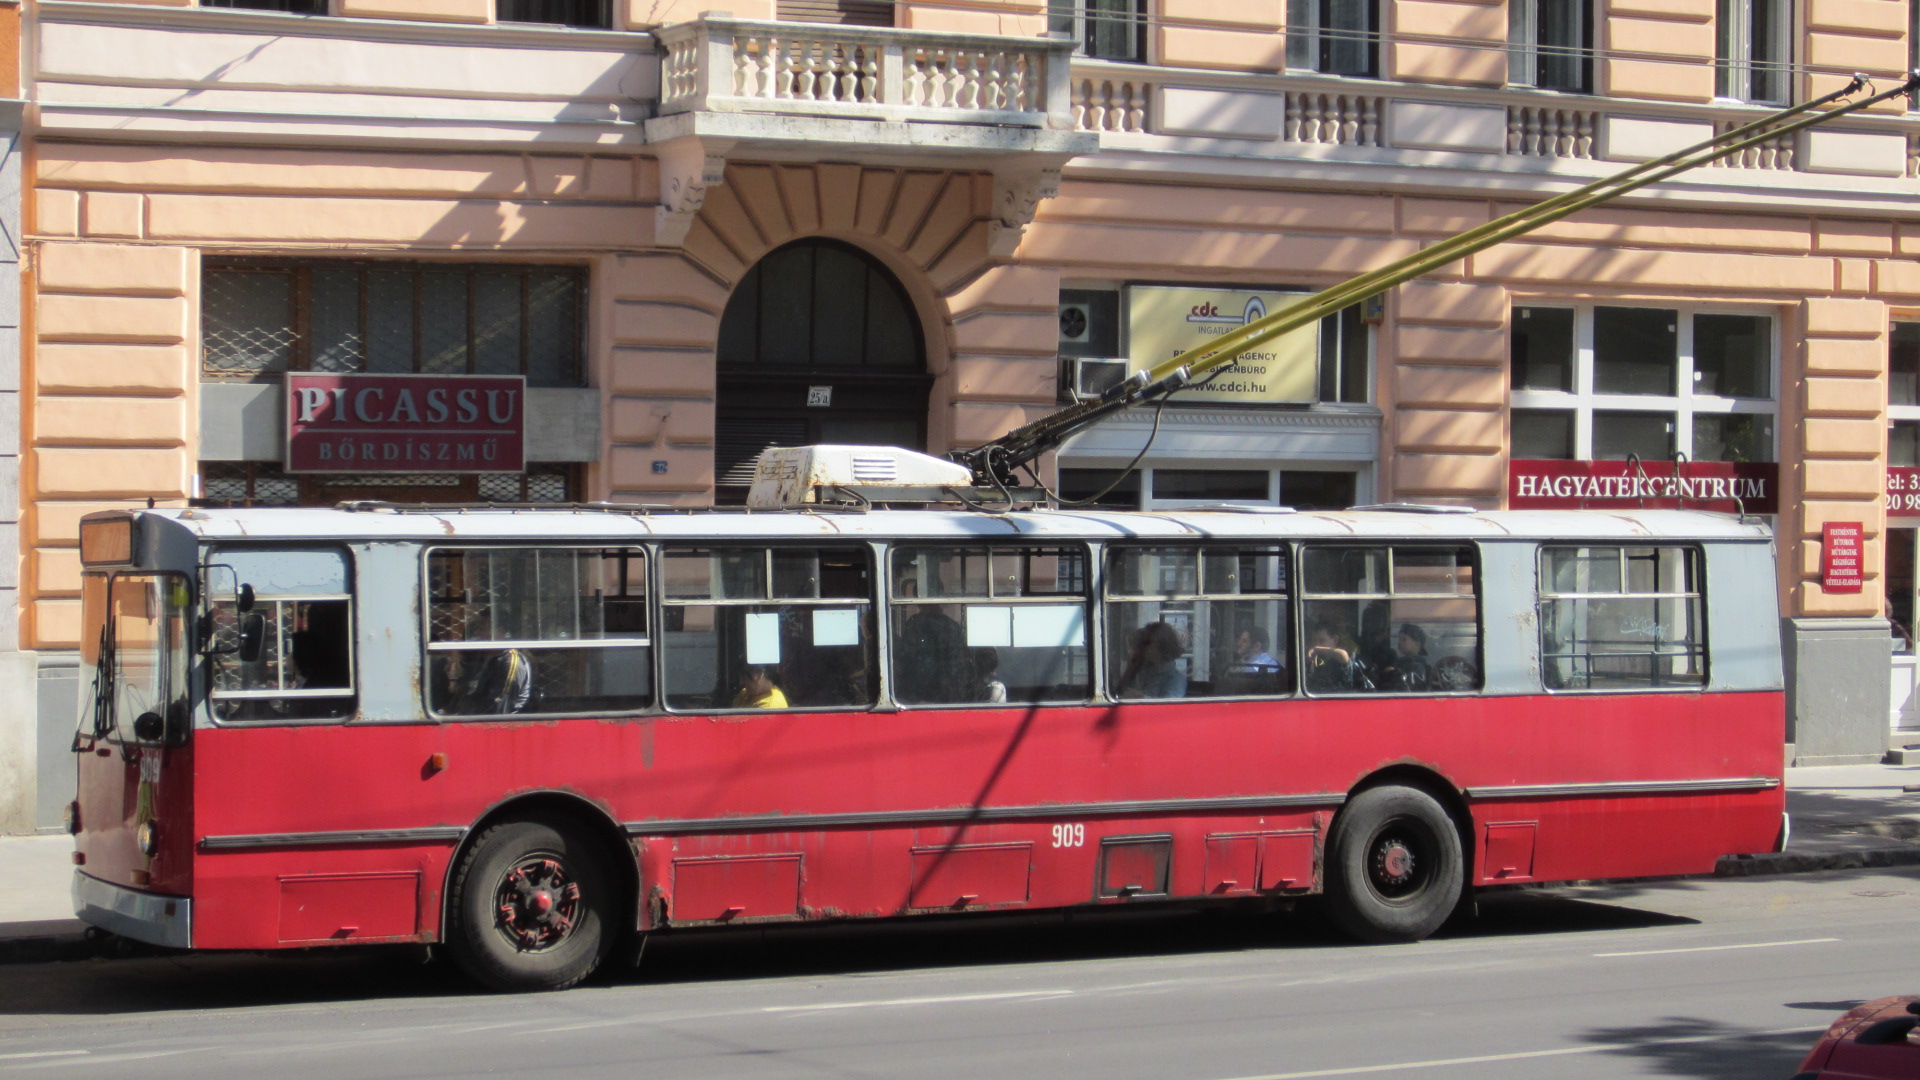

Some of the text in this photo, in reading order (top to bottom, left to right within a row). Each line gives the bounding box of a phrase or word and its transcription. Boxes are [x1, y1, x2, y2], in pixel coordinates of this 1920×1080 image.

[1191, 301, 1218, 317] cdc
[1239, 352, 1277, 361] AGENCY
[1184, 381, 1267, 393] ww.cdci.hu
[298, 387, 517, 424] PICASSU
[319, 438, 498, 461] BŐRDÍSZMŰ
[1517, 470, 1766, 498] HAGYATÉKCENTRUM
[1910, 473, 1920, 490] 3
[1052, 823, 1085, 848] 909
